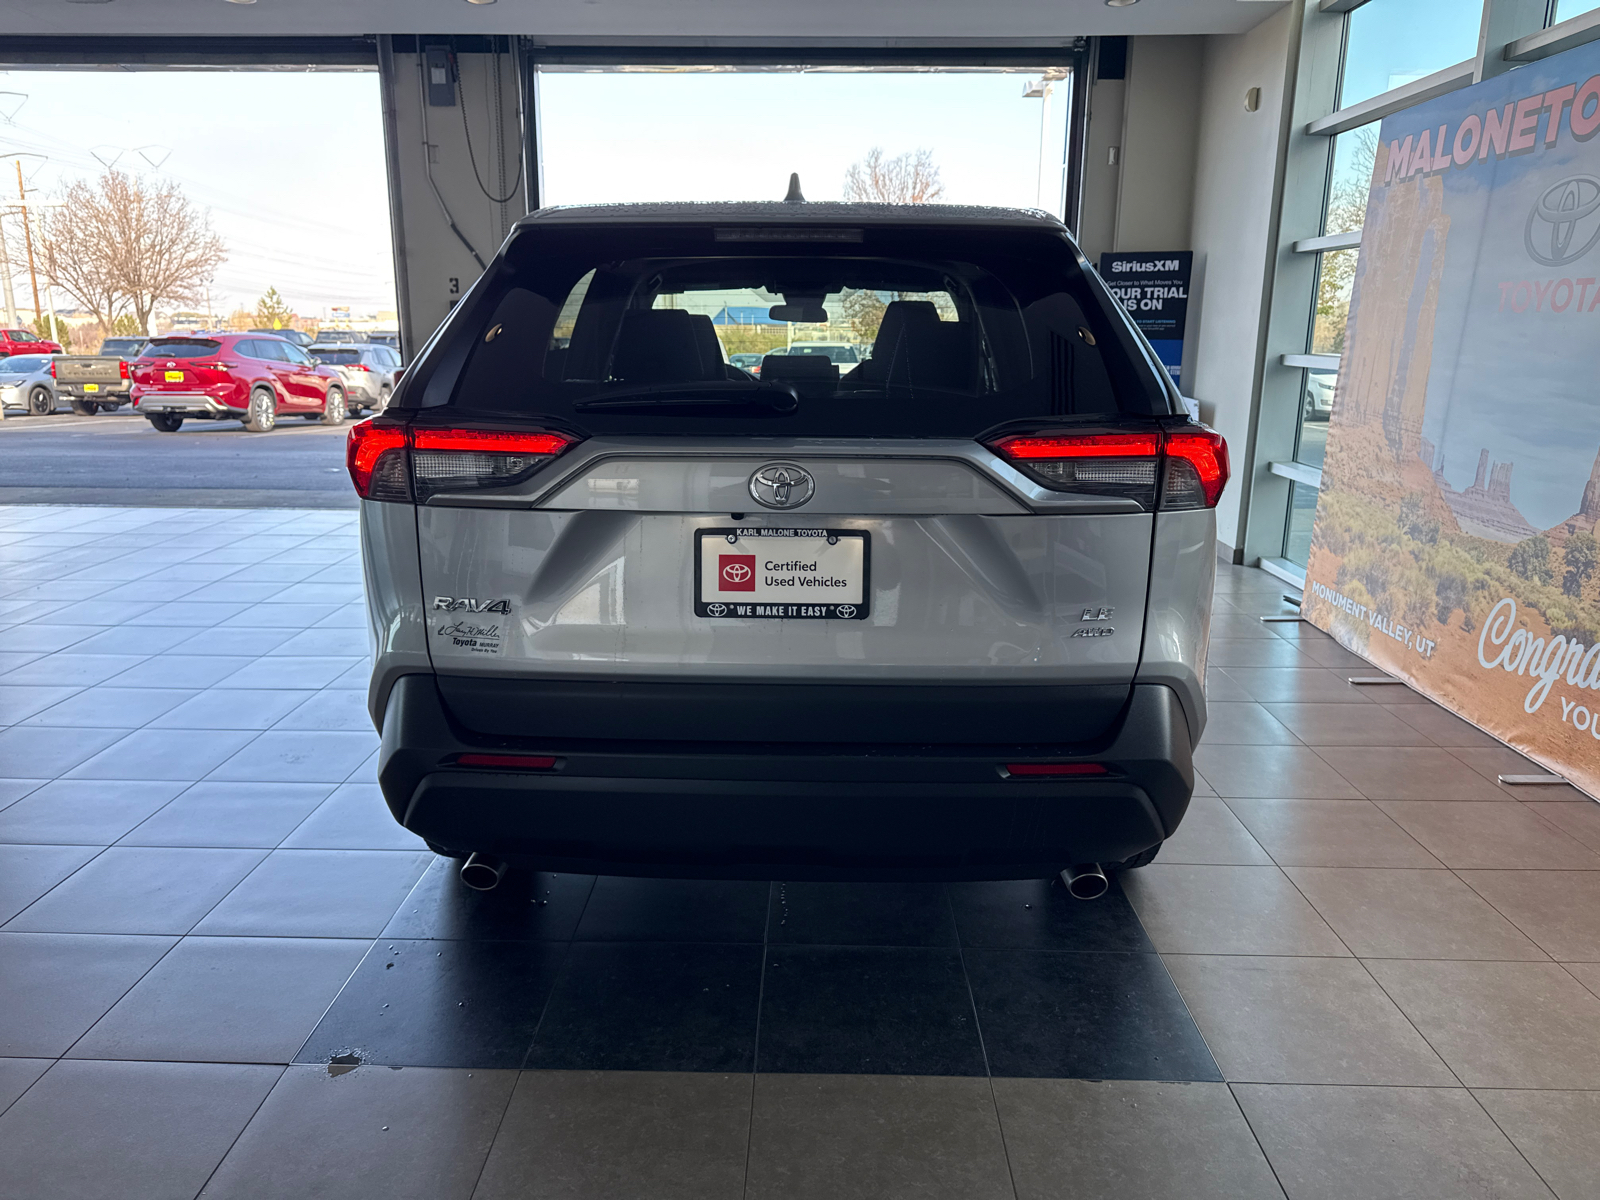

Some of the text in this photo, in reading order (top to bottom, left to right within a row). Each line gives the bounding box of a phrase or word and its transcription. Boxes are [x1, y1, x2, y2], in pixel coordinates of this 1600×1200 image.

[1112, 260, 1179, 273] SiriusXM
[449, 278, 459, 294] 3
[1111, 287, 1187, 299] OUR TRIAL
[1140, 299, 1163, 311] ON
[736, 528, 828, 537] KARL MALONE TOYOTA
[764, 560, 817, 572] Certified
[764, 576, 847, 588] Used Vehicles
[433, 596, 511, 615] RAV4
[737, 605, 827, 617] WE MAKE IT EASY
[1312, 580, 1435, 657] MONUMENT VALLEY, UT
[1071, 627, 1115, 639] AWD
[453, 637, 477, 648] Toyota
